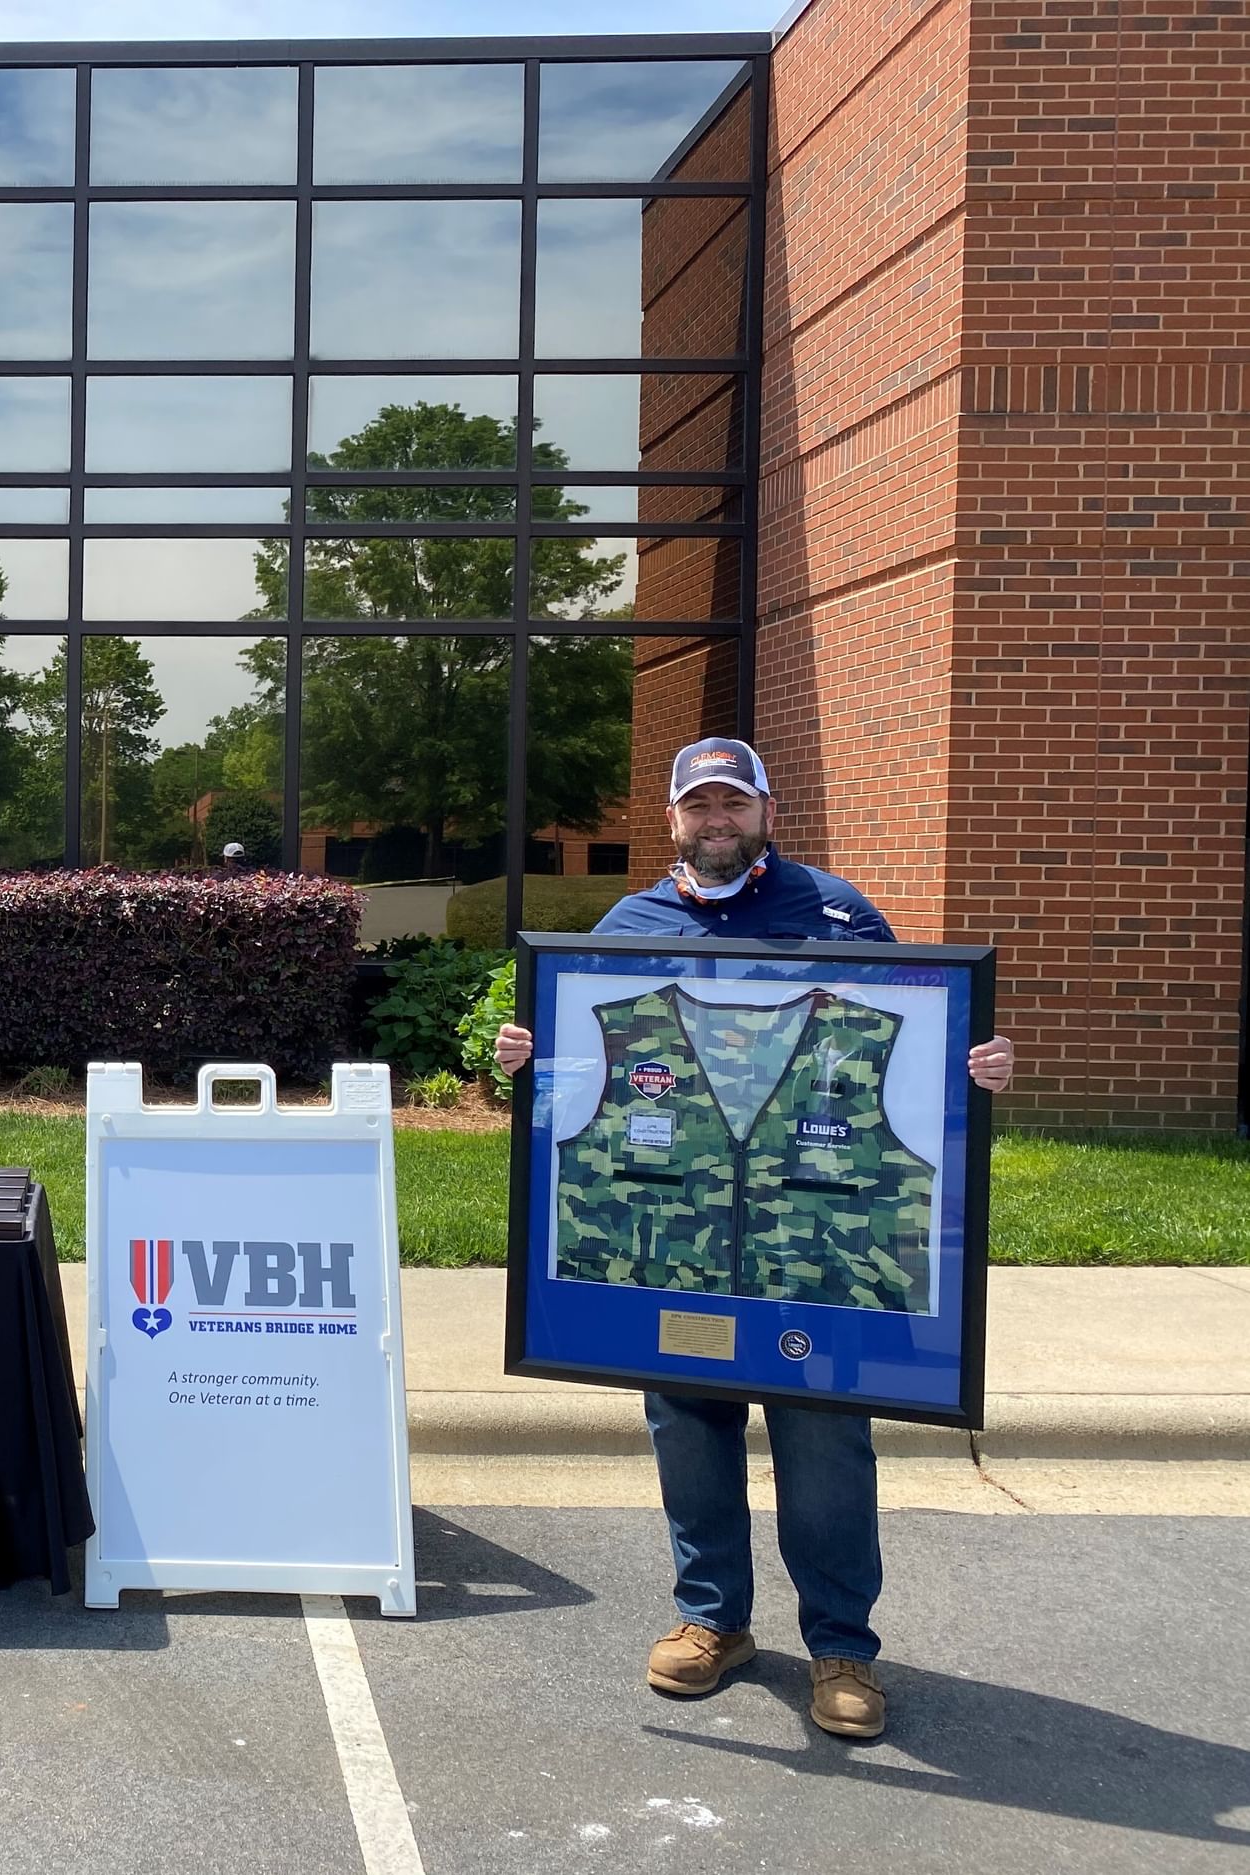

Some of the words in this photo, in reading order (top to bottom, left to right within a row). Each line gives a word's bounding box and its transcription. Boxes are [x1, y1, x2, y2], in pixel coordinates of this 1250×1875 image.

[690, 752, 735, 764] CLEMSON
[633, 1074, 672, 1084] VETERAN
[802, 1122, 846, 1137] LOWE'S
[796, 1140, 826, 1148] Customer
[182, 1240, 356, 1308] VBH
[188, 1320, 262, 1334] VETERANS
[265, 1320, 314, 1334] BRIDGE
[318, 1322, 358, 1336] HOME
[168, 1372, 178, 1384] A
[181, 1372, 238, 1390] stronger
[241, 1372, 320, 1390] community.
[168, 1392, 196, 1405] One
[200, 1391, 252, 1406] Veteran
[255, 1394, 270, 1406] at
[273, 1397, 282, 1406] a
[285, 1393, 320, 1408] time.
